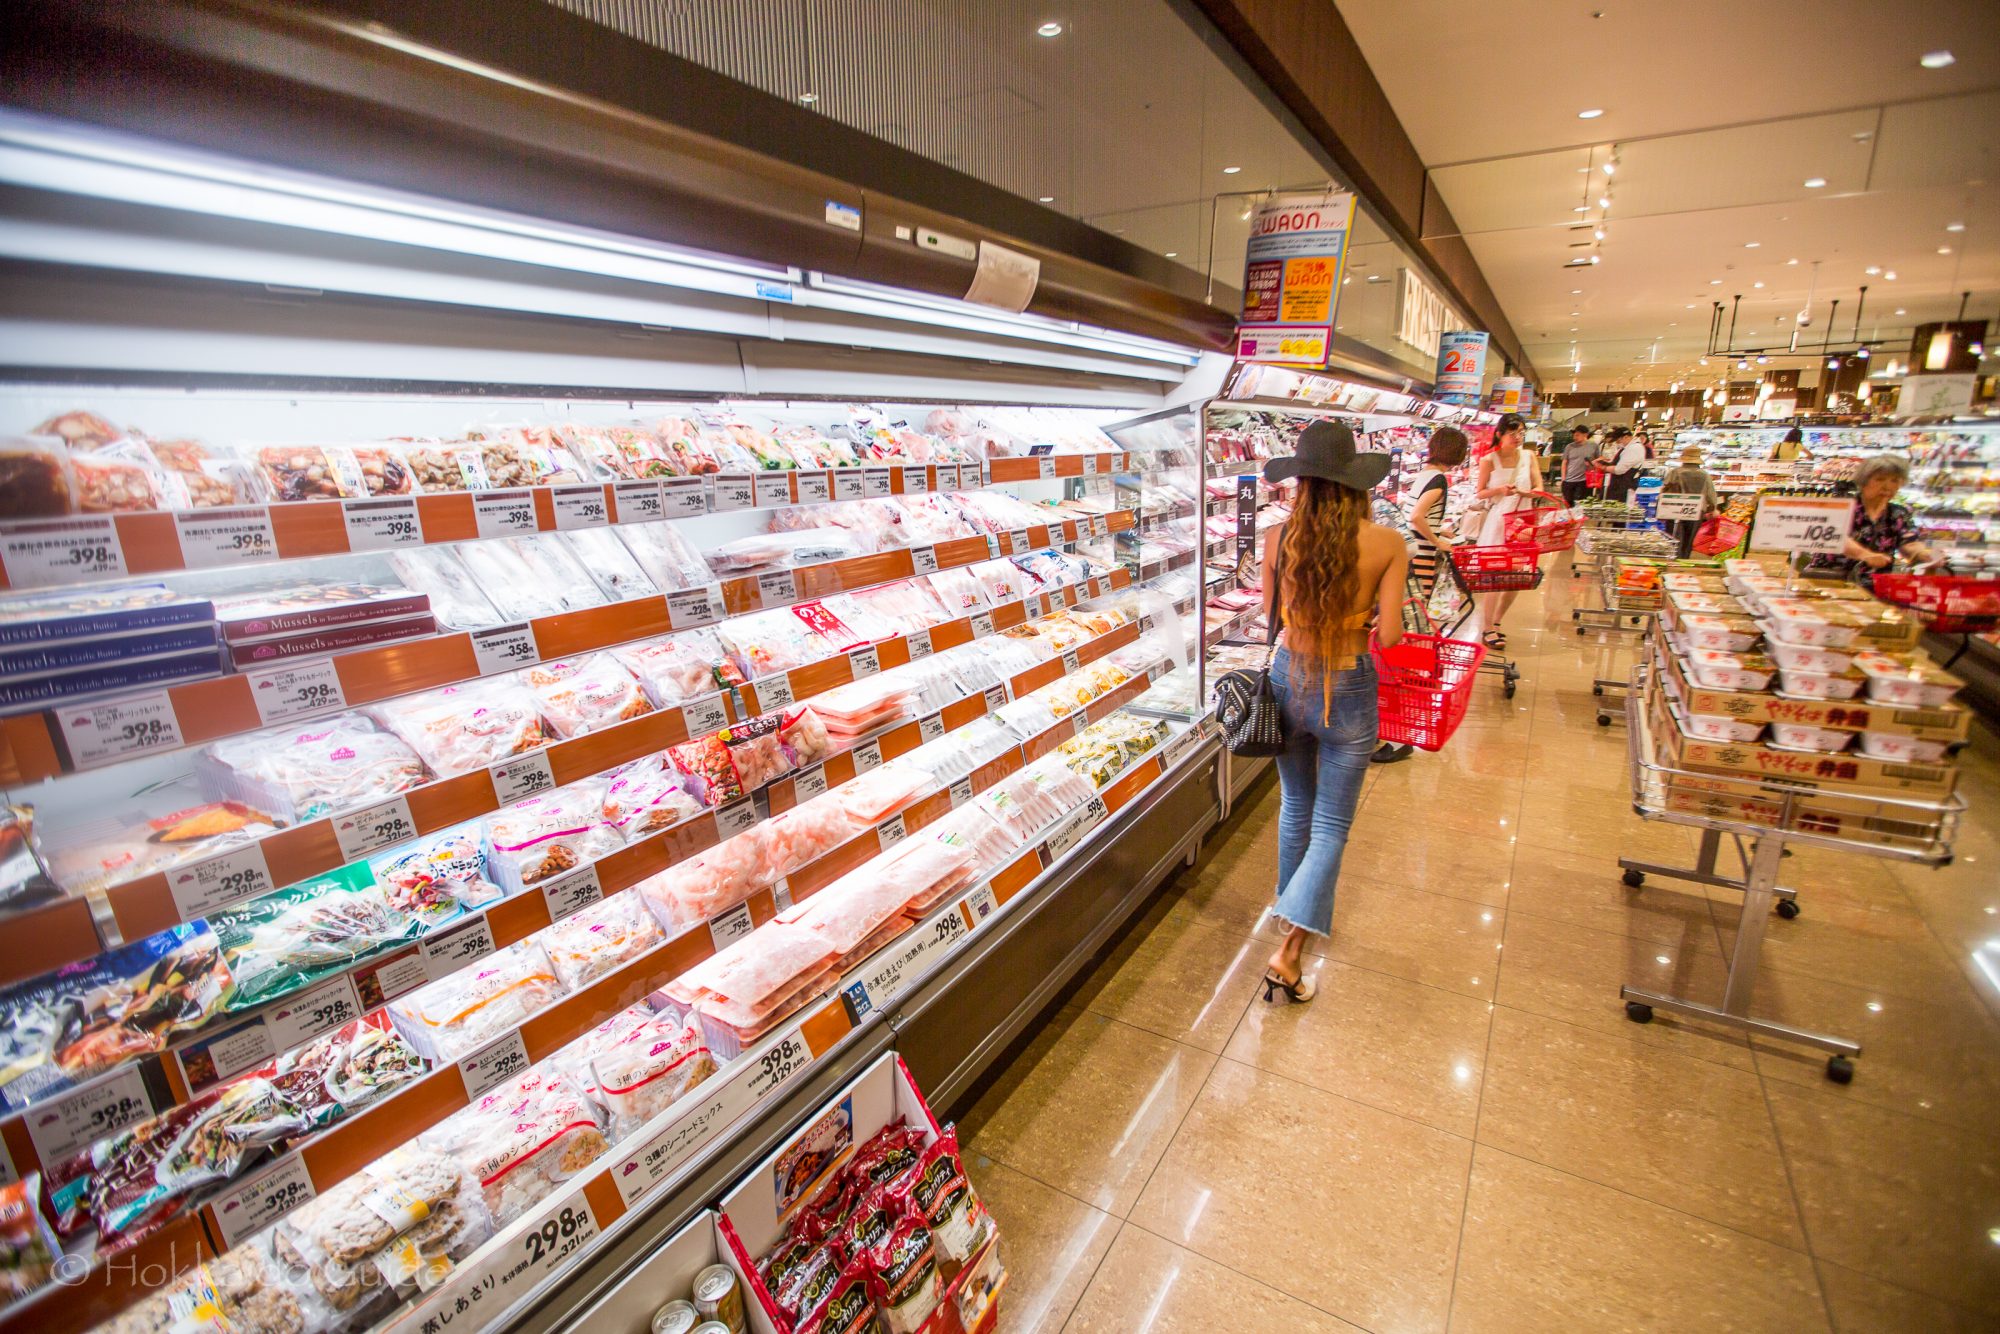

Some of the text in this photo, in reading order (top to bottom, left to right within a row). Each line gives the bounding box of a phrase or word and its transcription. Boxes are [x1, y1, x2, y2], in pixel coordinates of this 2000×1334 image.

[1262, 212, 1321, 232] WAON
[1444, 350, 1476, 373] 2倍
[387, 522, 417, 536] 398円
[233, 533, 271, 550] 398円
[69, 546, 117, 565] 398円
[93, 620, 118, 632] Butter
[271, 613, 318, 631] Mussels
[326, 613, 349, 622] Tomato
[350, 610, 366, 619] Garlic
[97, 647, 122, 659] Butter
[279, 639, 326, 655] Mussels
[328, 640, 333, 648] in
[334, 637, 356, 646] Tomato
[358, 634, 374, 643] Garlic
[509, 642, 534, 657] 358円
[103, 675, 128, 687] Butter
[297, 684, 337, 701] 398円
[122, 719, 172, 739] 398円
[523, 771, 549, 786] 398円
[375, 818, 410, 836] 298円
[220, 869, 263, 890] 298円
[573, 884, 597, 900] 398円
[936, 913, 962, 941] 298円
[463, 936, 489, 955] 398円
[313, 1000, 352, 1022] 398円
[495, 1052, 524, 1073] 298円
[761, 1040, 801, 1075] 398円
[91, 1097, 142, 1126] 398円
[645, 1102, 723, 1166] 3種のシーフードミックス
[265, 1182, 306, 1210] 398円
[420, 1273, 496, 1334] 蒸しあさり
[525, 1207, 589, 1267] 298円
